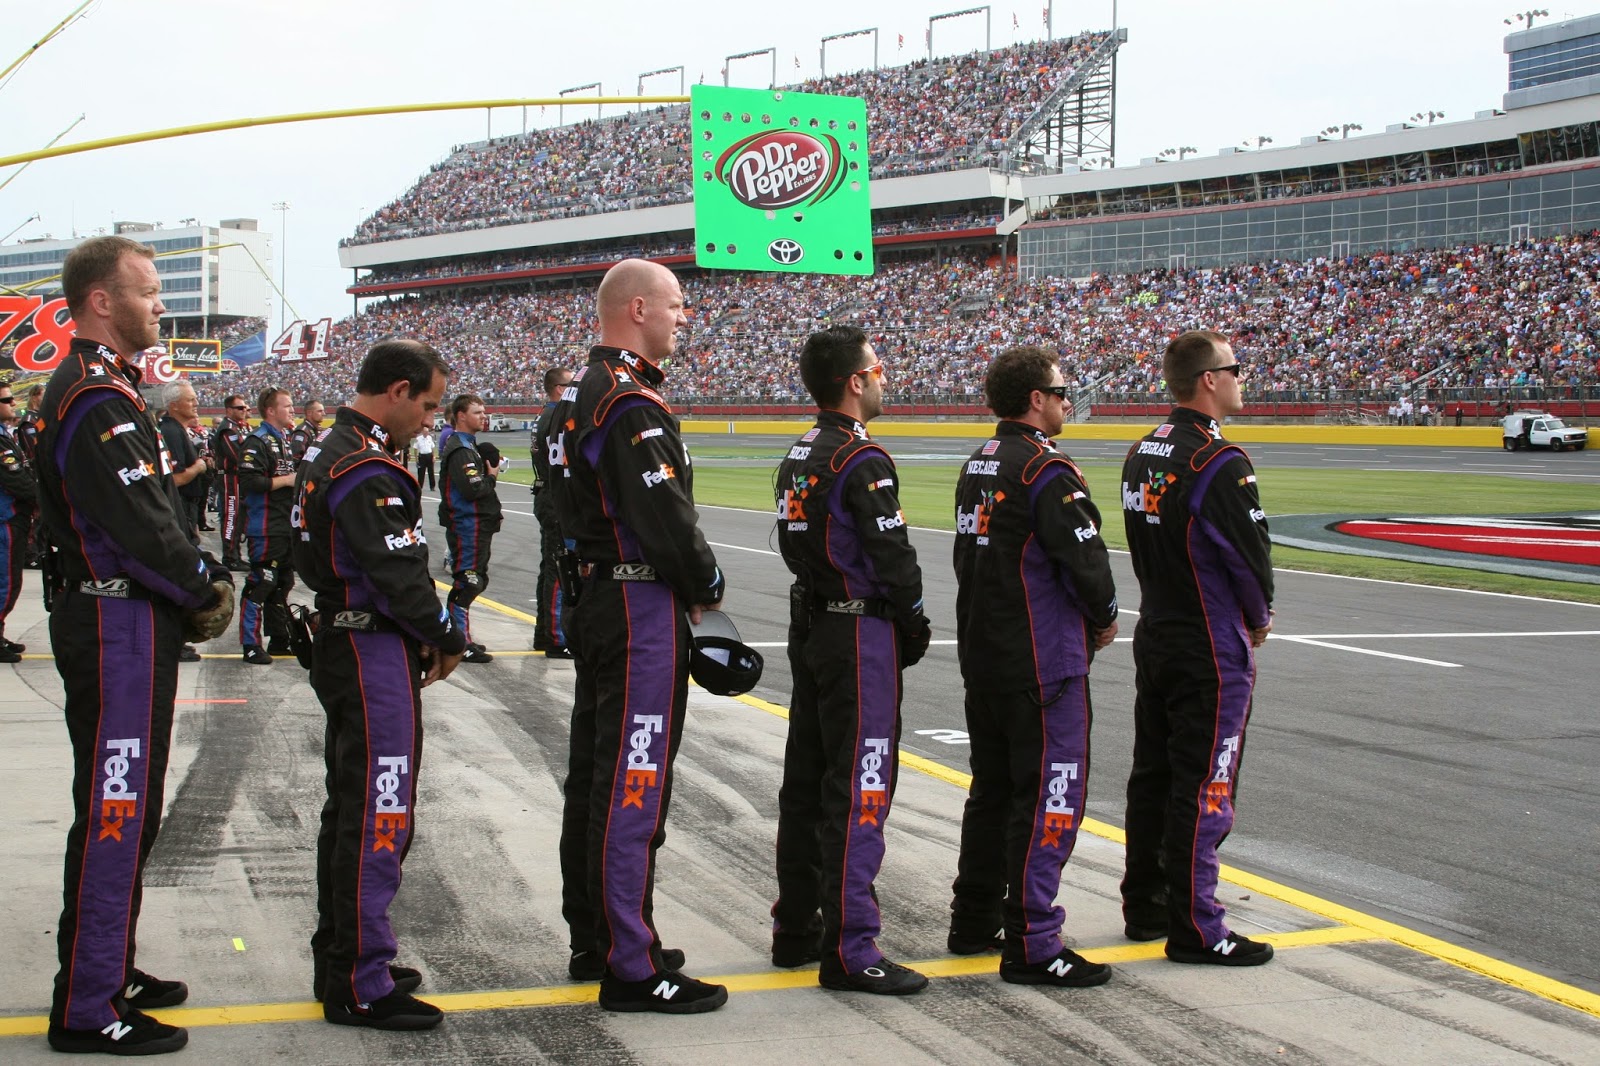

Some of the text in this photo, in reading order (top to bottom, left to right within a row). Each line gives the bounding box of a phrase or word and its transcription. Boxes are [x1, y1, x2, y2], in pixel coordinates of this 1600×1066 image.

[732, 151, 821, 201] Pepper
[762, 142, 797, 172] Dr
[0, 295, 78, 372] 78
[273, 319, 331, 362] 41
[1137, 441, 1174, 458] PEGRAM
[98, 738, 140, 842] FedEx
[621, 714, 663, 810] FedEx
[858, 737, 889, 826] FedEx
[1206, 735, 1239, 815] FedEx
[372, 755, 408, 853] FedEx
[1040, 762, 1078, 849] FedEx
[652, 980, 679, 1000] N
[1047, 958, 1073, 977] N
[101, 1021, 133, 1041] N
